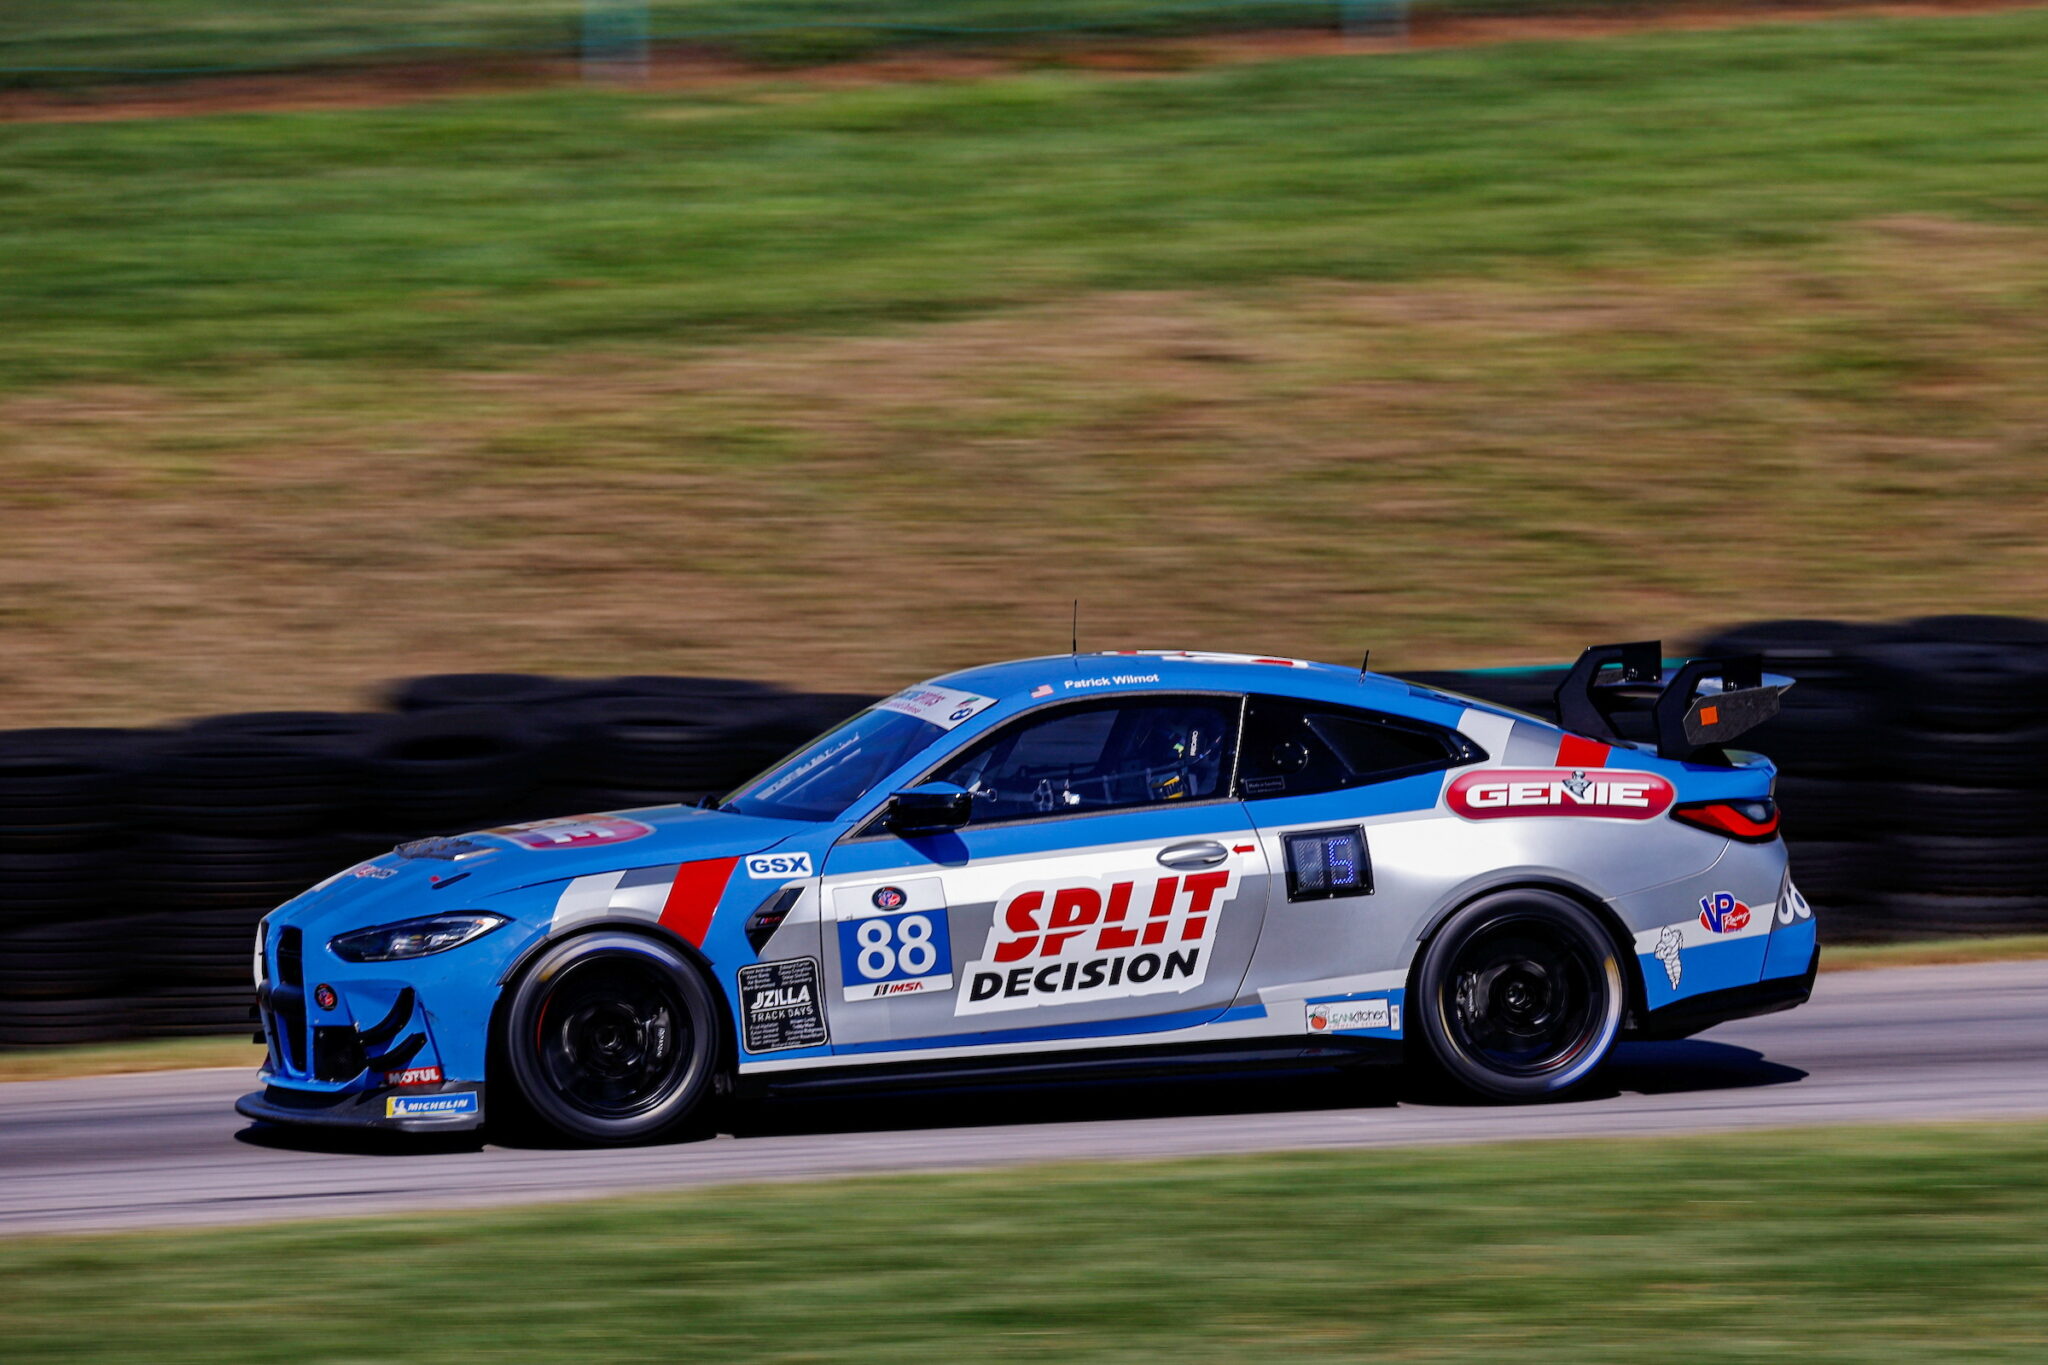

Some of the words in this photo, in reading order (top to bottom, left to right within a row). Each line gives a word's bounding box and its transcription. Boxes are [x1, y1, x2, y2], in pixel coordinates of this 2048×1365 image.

[1064, 677, 1111, 689] Patrick
[1112, 674, 1160, 685] Wilmot
[1466, 781, 1651, 808] GENIE
[750, 857, 809, 873] GSX
[993, 870, 1230, 963] SPLIT
[1700, 891, 1735, 934] VP
[857, 914, 937, 980] 88
[969, 948, 1201, 1002] DECISION
[750, 984, 811, 1010] JZILLA
[889, 982, 924, 993] IMSA
[751, 1009, 785, 1022] TRACK
[787, 1005, 814, 1018] DAYS
[388, 1068, 441, 1084] MOTUL
[407, 1098, 469, 1111] MICHELIN
